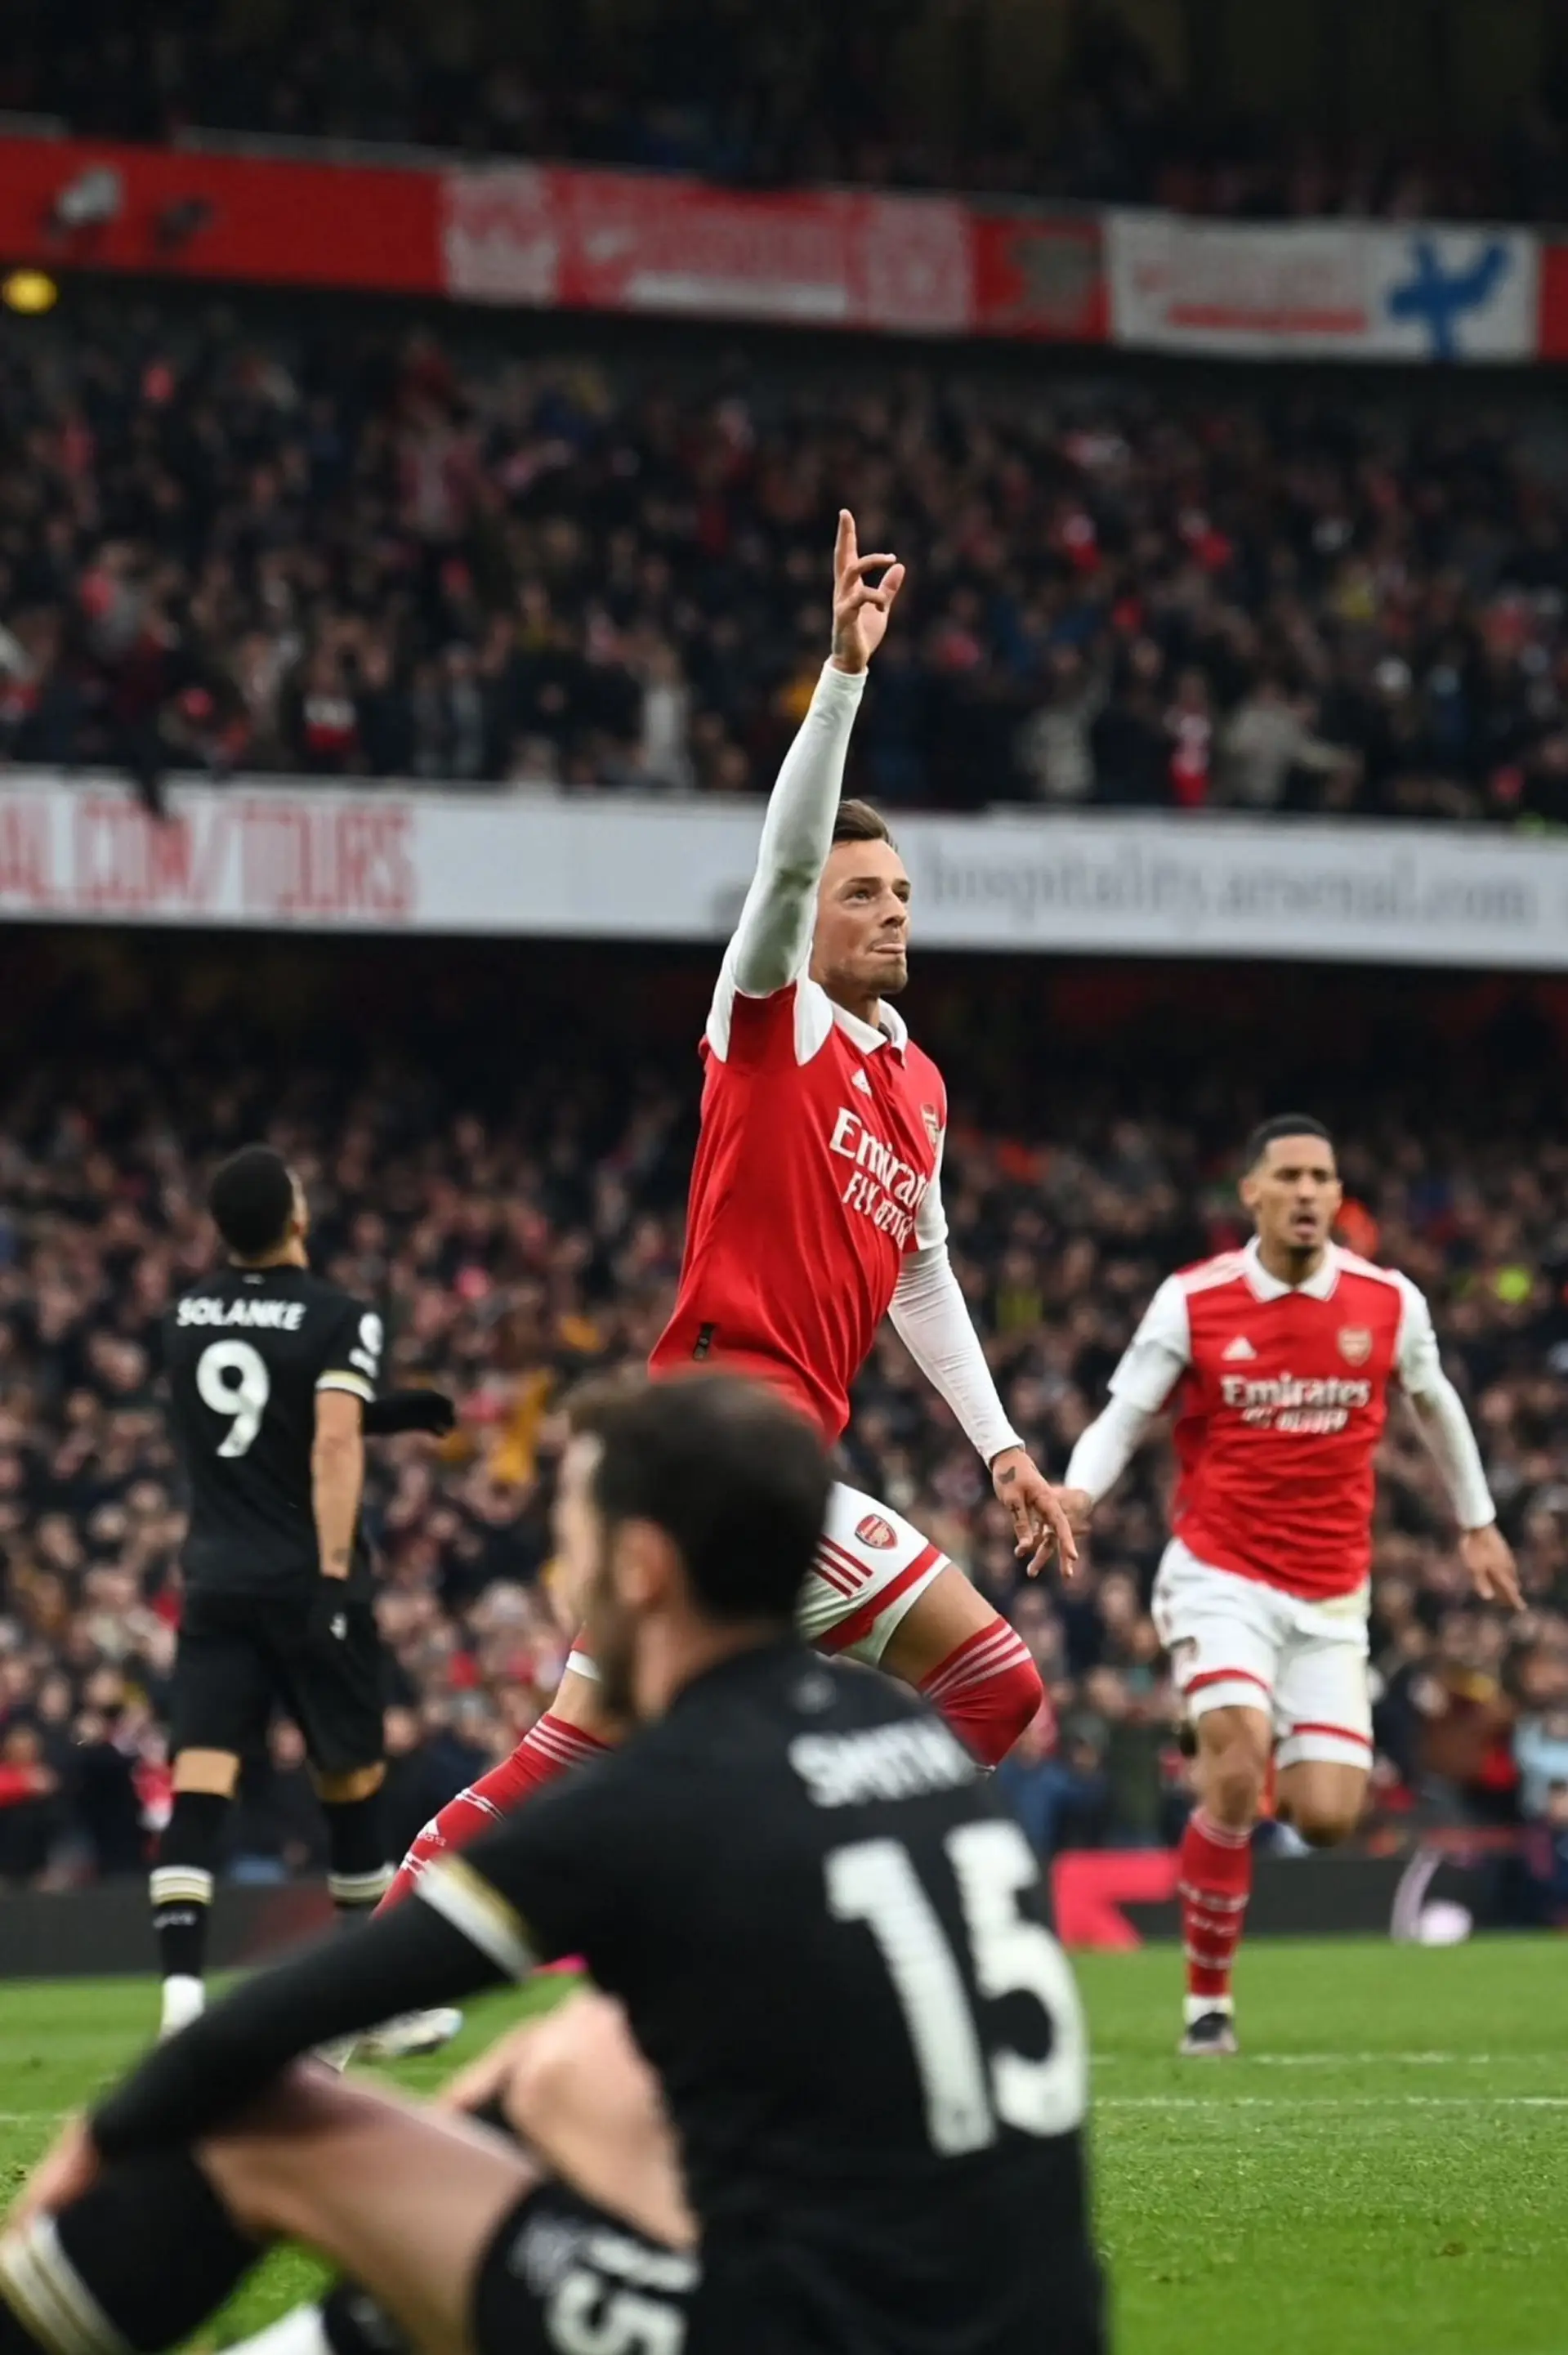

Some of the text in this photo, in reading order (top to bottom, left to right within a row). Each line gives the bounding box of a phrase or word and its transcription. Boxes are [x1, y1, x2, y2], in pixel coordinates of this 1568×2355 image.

[176, 1297, 306, 1330] SOLANKE
[196, 1338, 270, 1458] 9
[1221, 1370, 1371, 1408] Emirates
[824, 1817, 1088, 2157] 15
